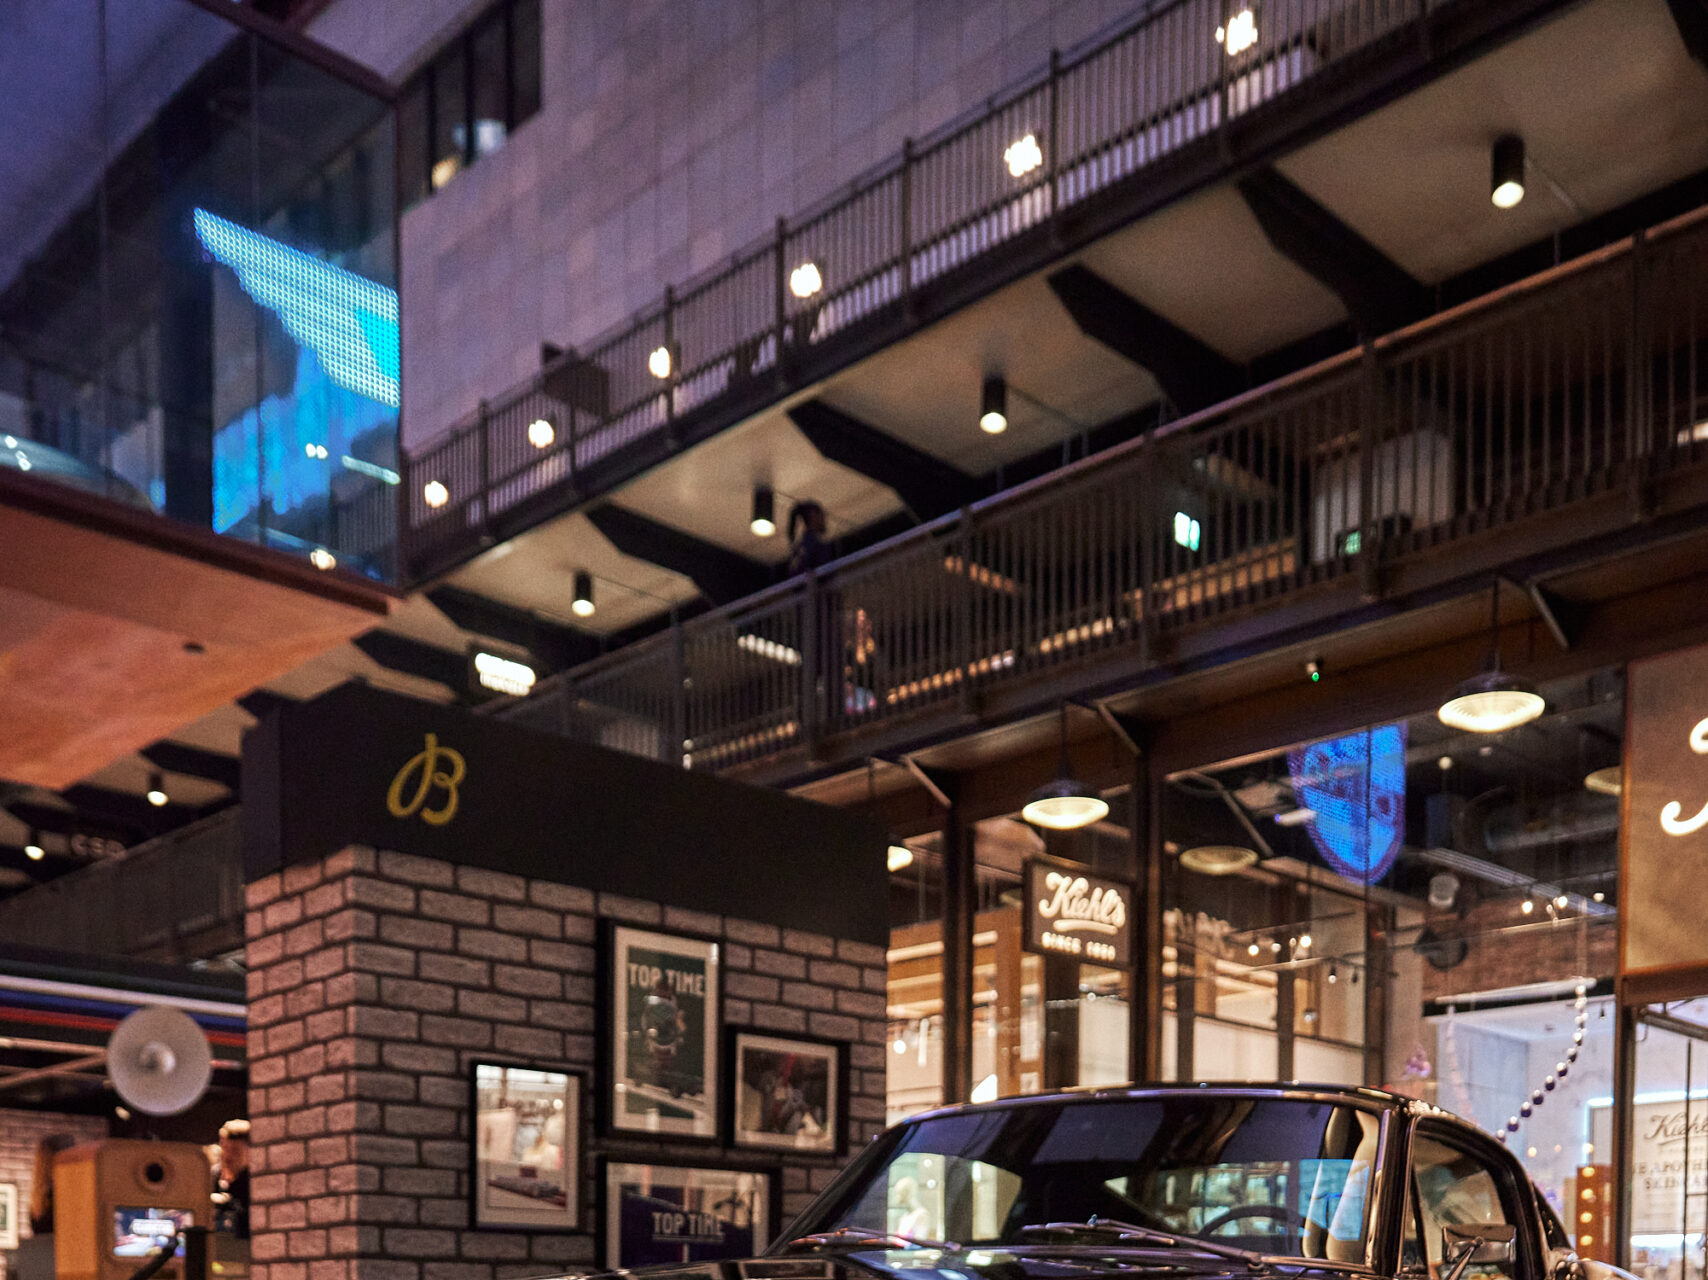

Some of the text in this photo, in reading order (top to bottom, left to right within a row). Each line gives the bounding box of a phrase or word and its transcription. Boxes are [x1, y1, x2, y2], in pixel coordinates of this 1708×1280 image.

[628, 963, 706, 998] TOP TIME
[651, 1211, 727, 1237] TOP TIME
